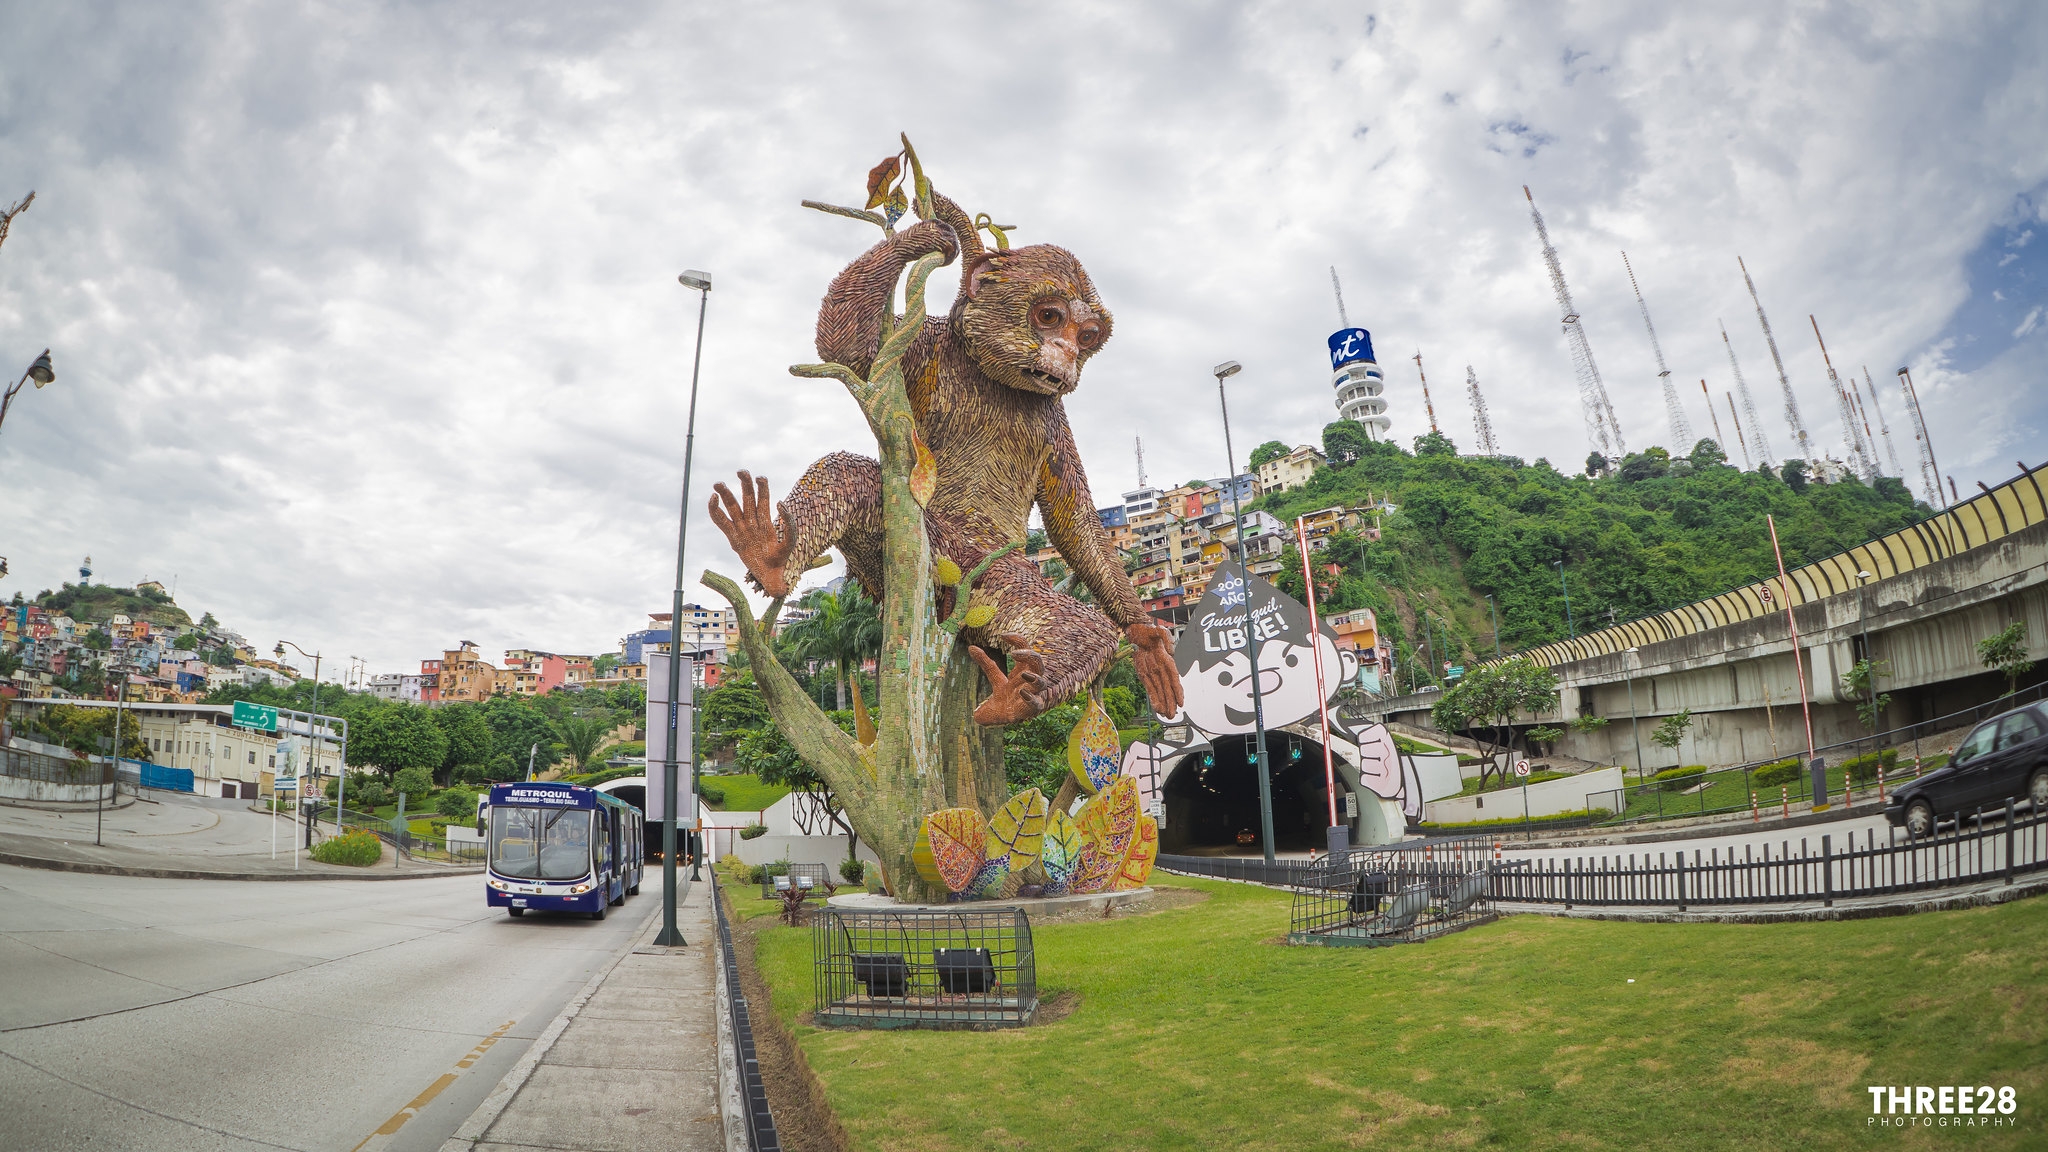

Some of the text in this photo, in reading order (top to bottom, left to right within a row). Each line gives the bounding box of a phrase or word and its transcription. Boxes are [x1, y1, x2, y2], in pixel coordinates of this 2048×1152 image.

[1218, 577, 1243, 592] 200
[1219, 588, 1253, 606] AÑOS
[1203, 612, 1289, 652] LIBRE!
[511, 789, 573, 799] METROQUIL
